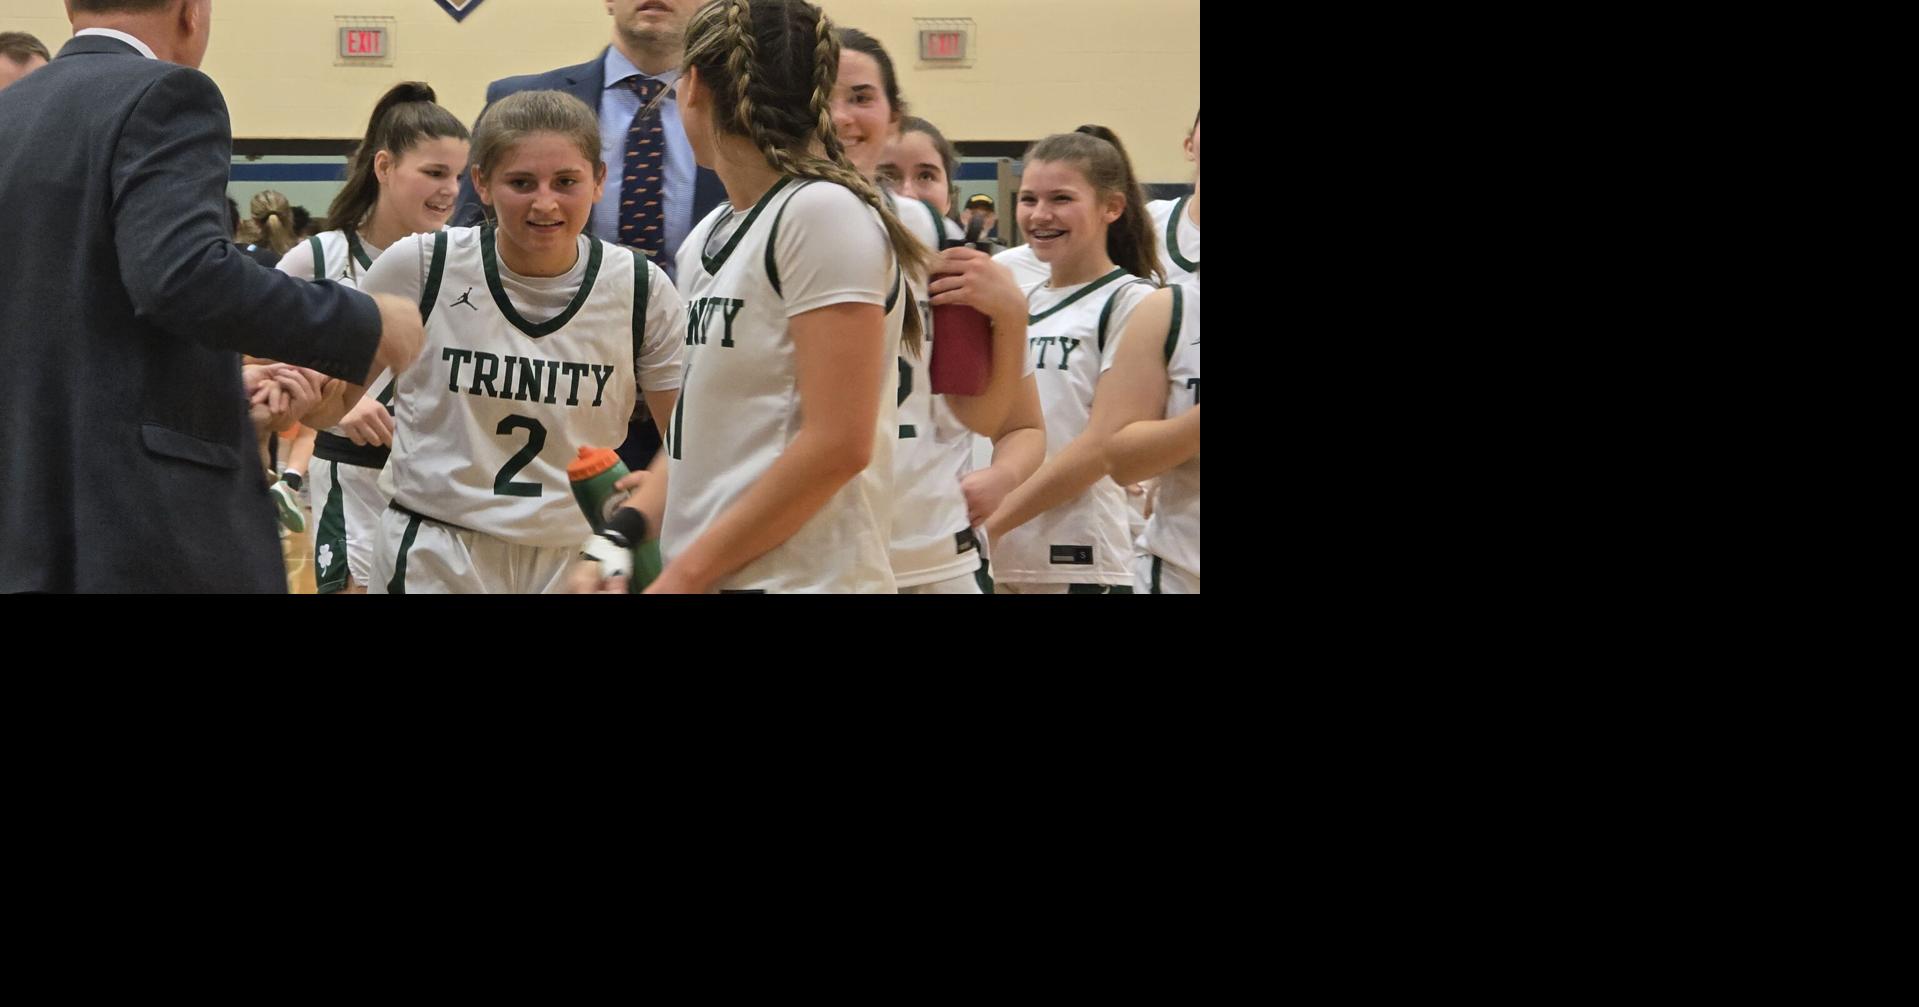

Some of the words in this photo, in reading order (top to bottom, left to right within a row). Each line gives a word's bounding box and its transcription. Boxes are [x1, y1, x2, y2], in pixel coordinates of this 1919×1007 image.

[347, 30, 381, 54] EXIT
[442, 346, 614, 407] TRINITY
[493, 413, 547, 497] 2
